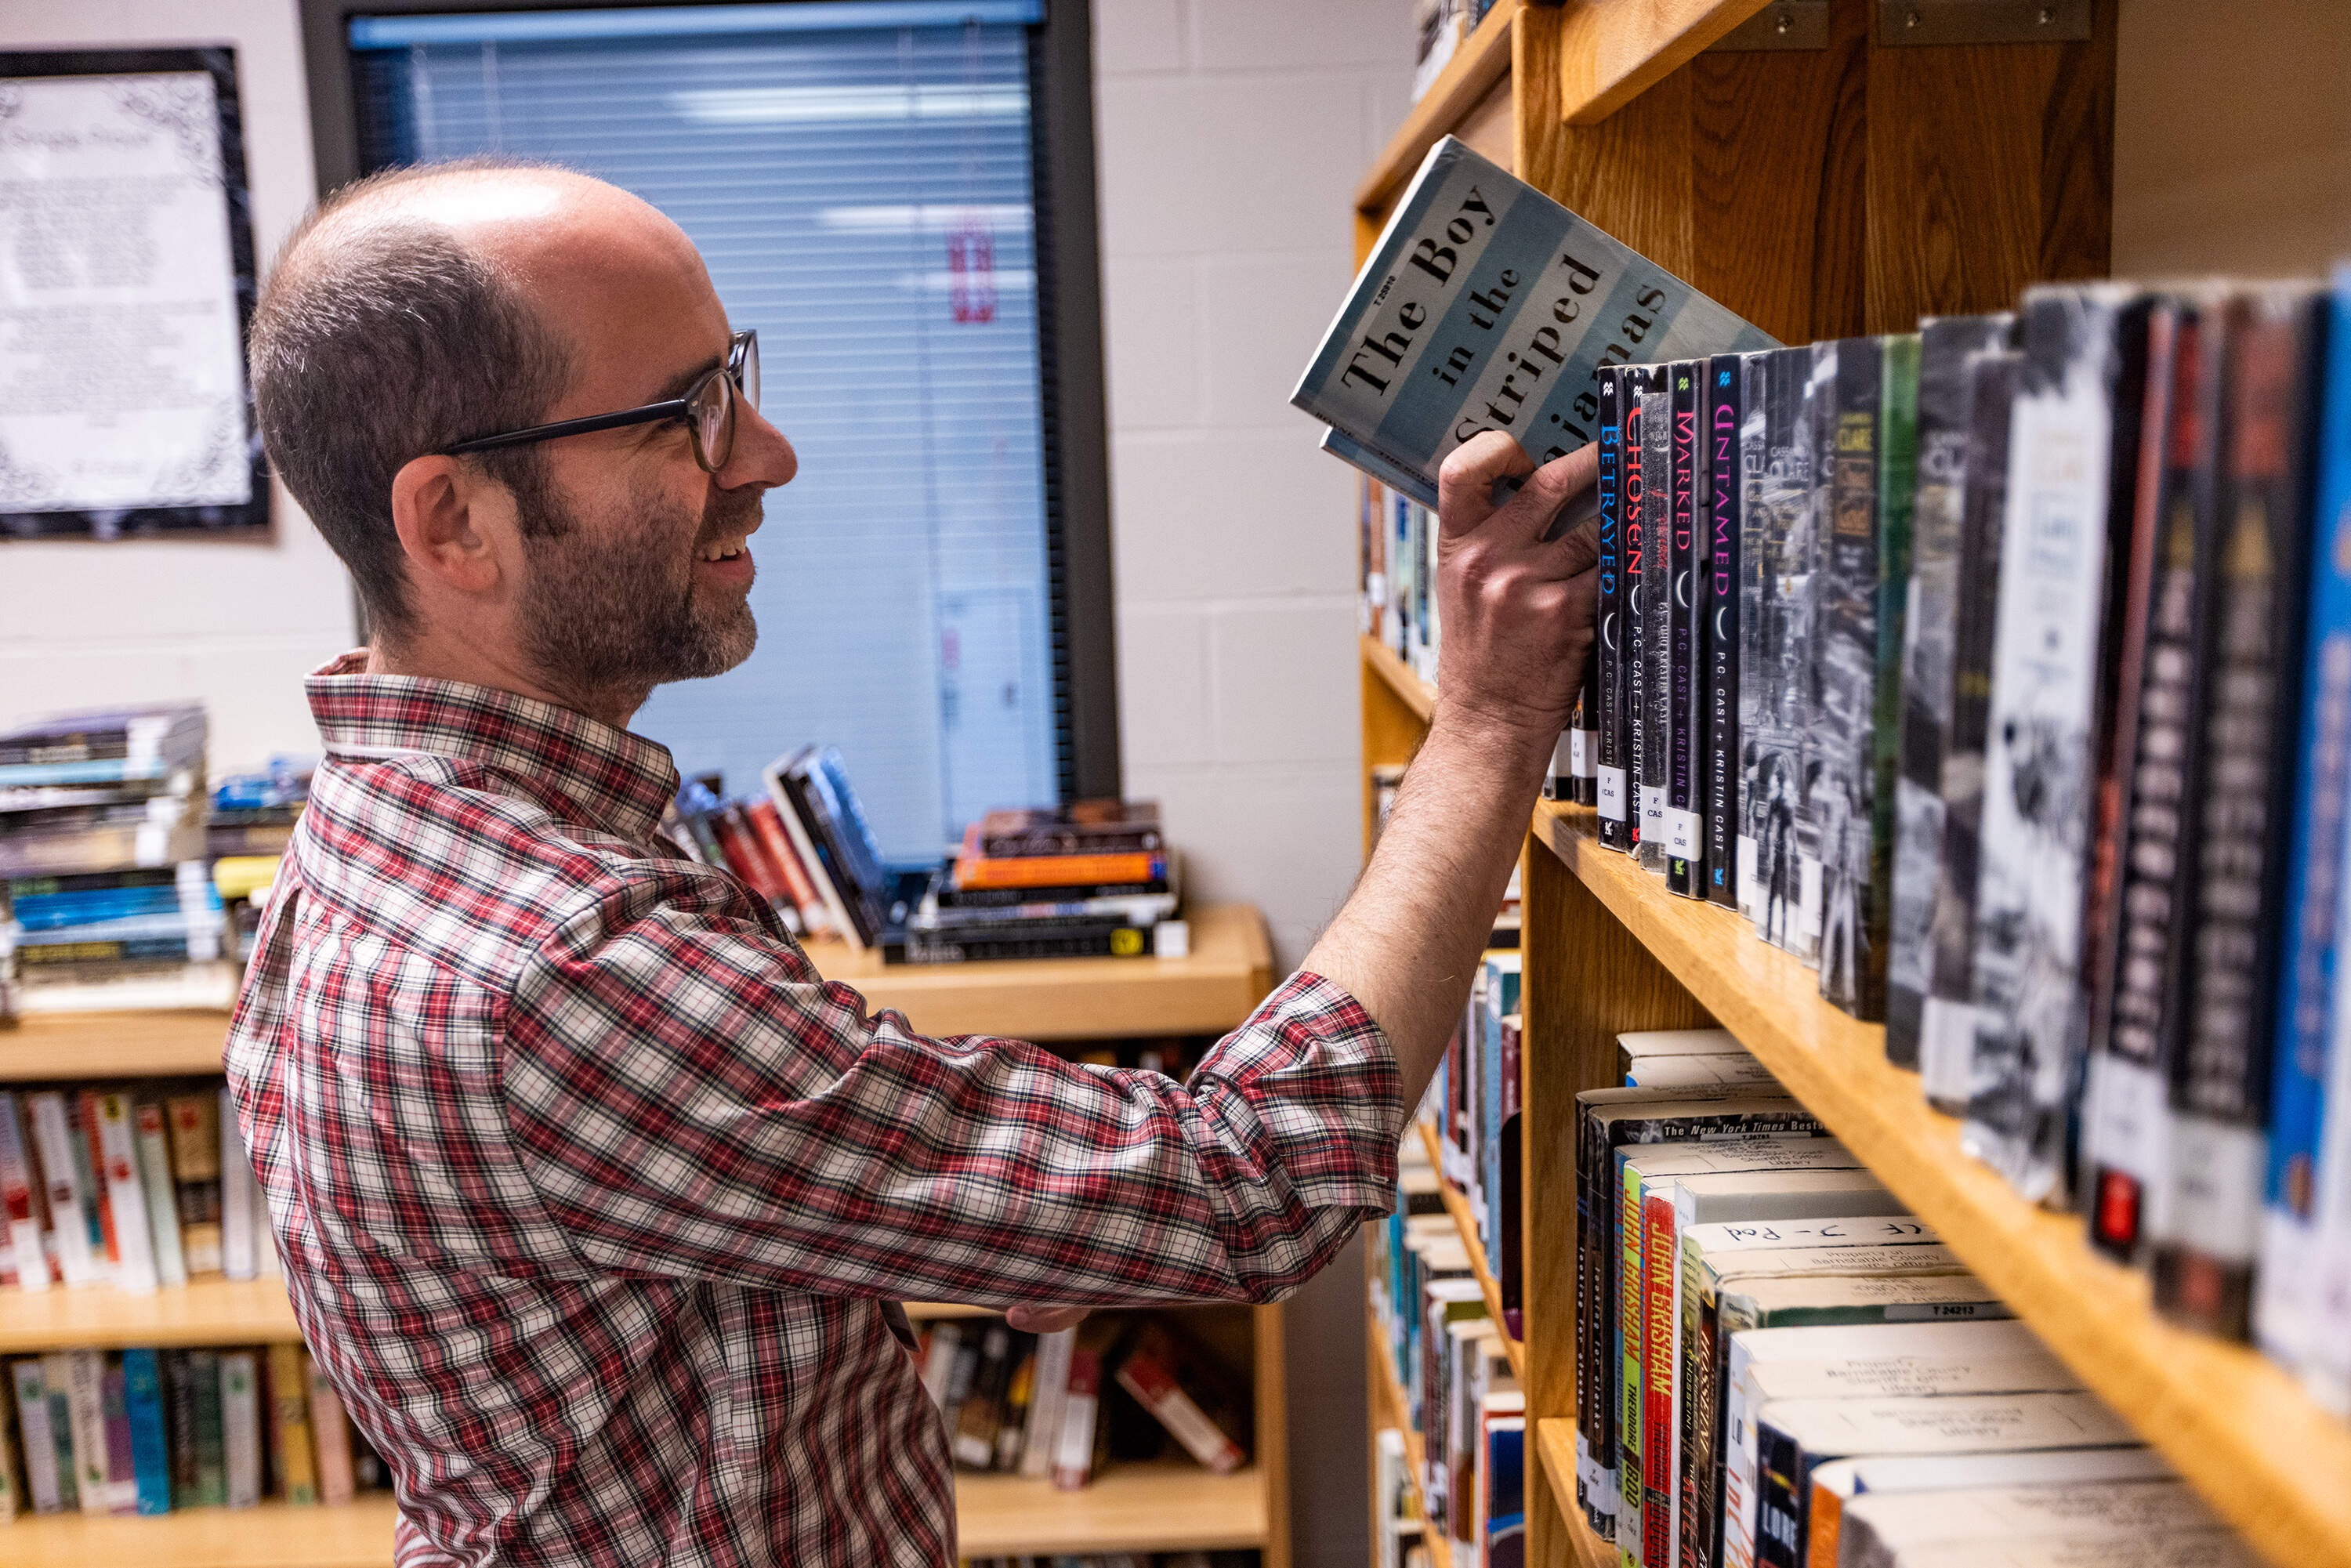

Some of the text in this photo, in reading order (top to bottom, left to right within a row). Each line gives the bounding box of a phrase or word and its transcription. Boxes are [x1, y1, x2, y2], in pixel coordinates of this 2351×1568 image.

[1341, 185, 1496, 396] The Boy
[1432, 267, 1521, 387] in the
[1455, 253, 1605, 445] Striped
[1541, 284, 1667, 467] ajamas
[1601, 424, 1619, 594] BETRAYED
[1627, 407, 1642, 574] CHOSEN
[1674, 411, 1694, 550] MARKED
[1715, 404, 1734, 596] UNTAMED
[1632, 626, 1642, 653] P.C.
[1677, 628, 1687, 656] P.C.
[1716, 652, 1726, 679] P.C.
[1632, 660, 1642, 697] CAST
[1677, 664, 1687, 701] CAST
[1716, 688, 1726, 725] CAST
[1632, 719, 1642, 775] KRISTIN
[1676, 727, 1686, 788] KRISTIN
[1632, 781, 1642, 816] CAST
[1715, 749, 1725, 808] KRISTIN
[1647, 809, 1663, 819] CAS
[1674, 837, 1687, 847] CAS
[1714, 815, 1724, 853] CAST
[1665, 1121, 1825, 1136] The New York Times Bests
[1625, 1189, 1640, 1363] JOHN GRISHAM
[1650, 1222, 1672, 1397] JOHN GRISHAM
[1627, 1382, 1637, 1454] THEODORE
[1700, 1330, 1710, 1454] HOSSEINI
[1625, 1464, 1639, 1509] BOO
